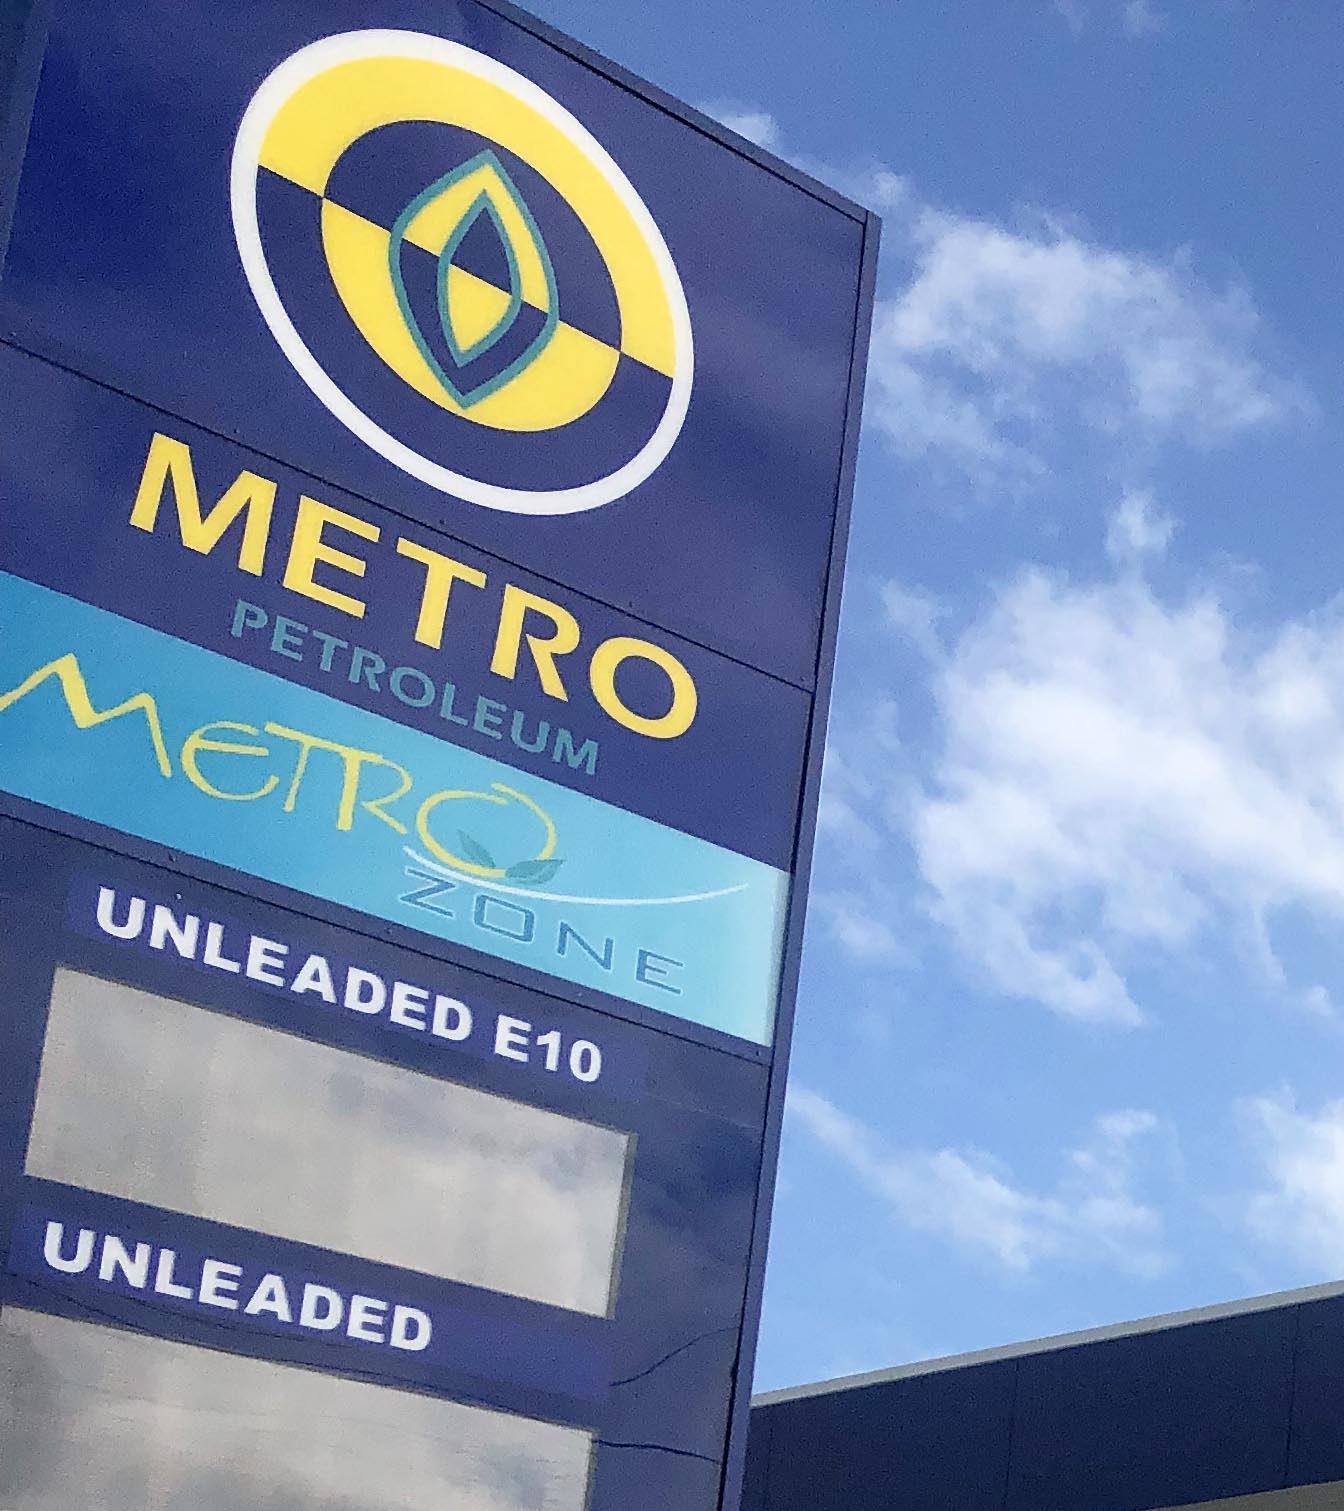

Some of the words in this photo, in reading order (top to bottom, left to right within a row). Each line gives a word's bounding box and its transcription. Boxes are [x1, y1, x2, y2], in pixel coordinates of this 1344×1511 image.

[130, 433, 698, 740] METRO
[231, 599, 599, 776] PETROLEUM
[96, 887, 472, 1042] UNLEADED
[493, 1013, 603, 1084] E10
[400, 867, 684, 995] ZONE
[43, 1221, 433, 1352] UNLEADED
